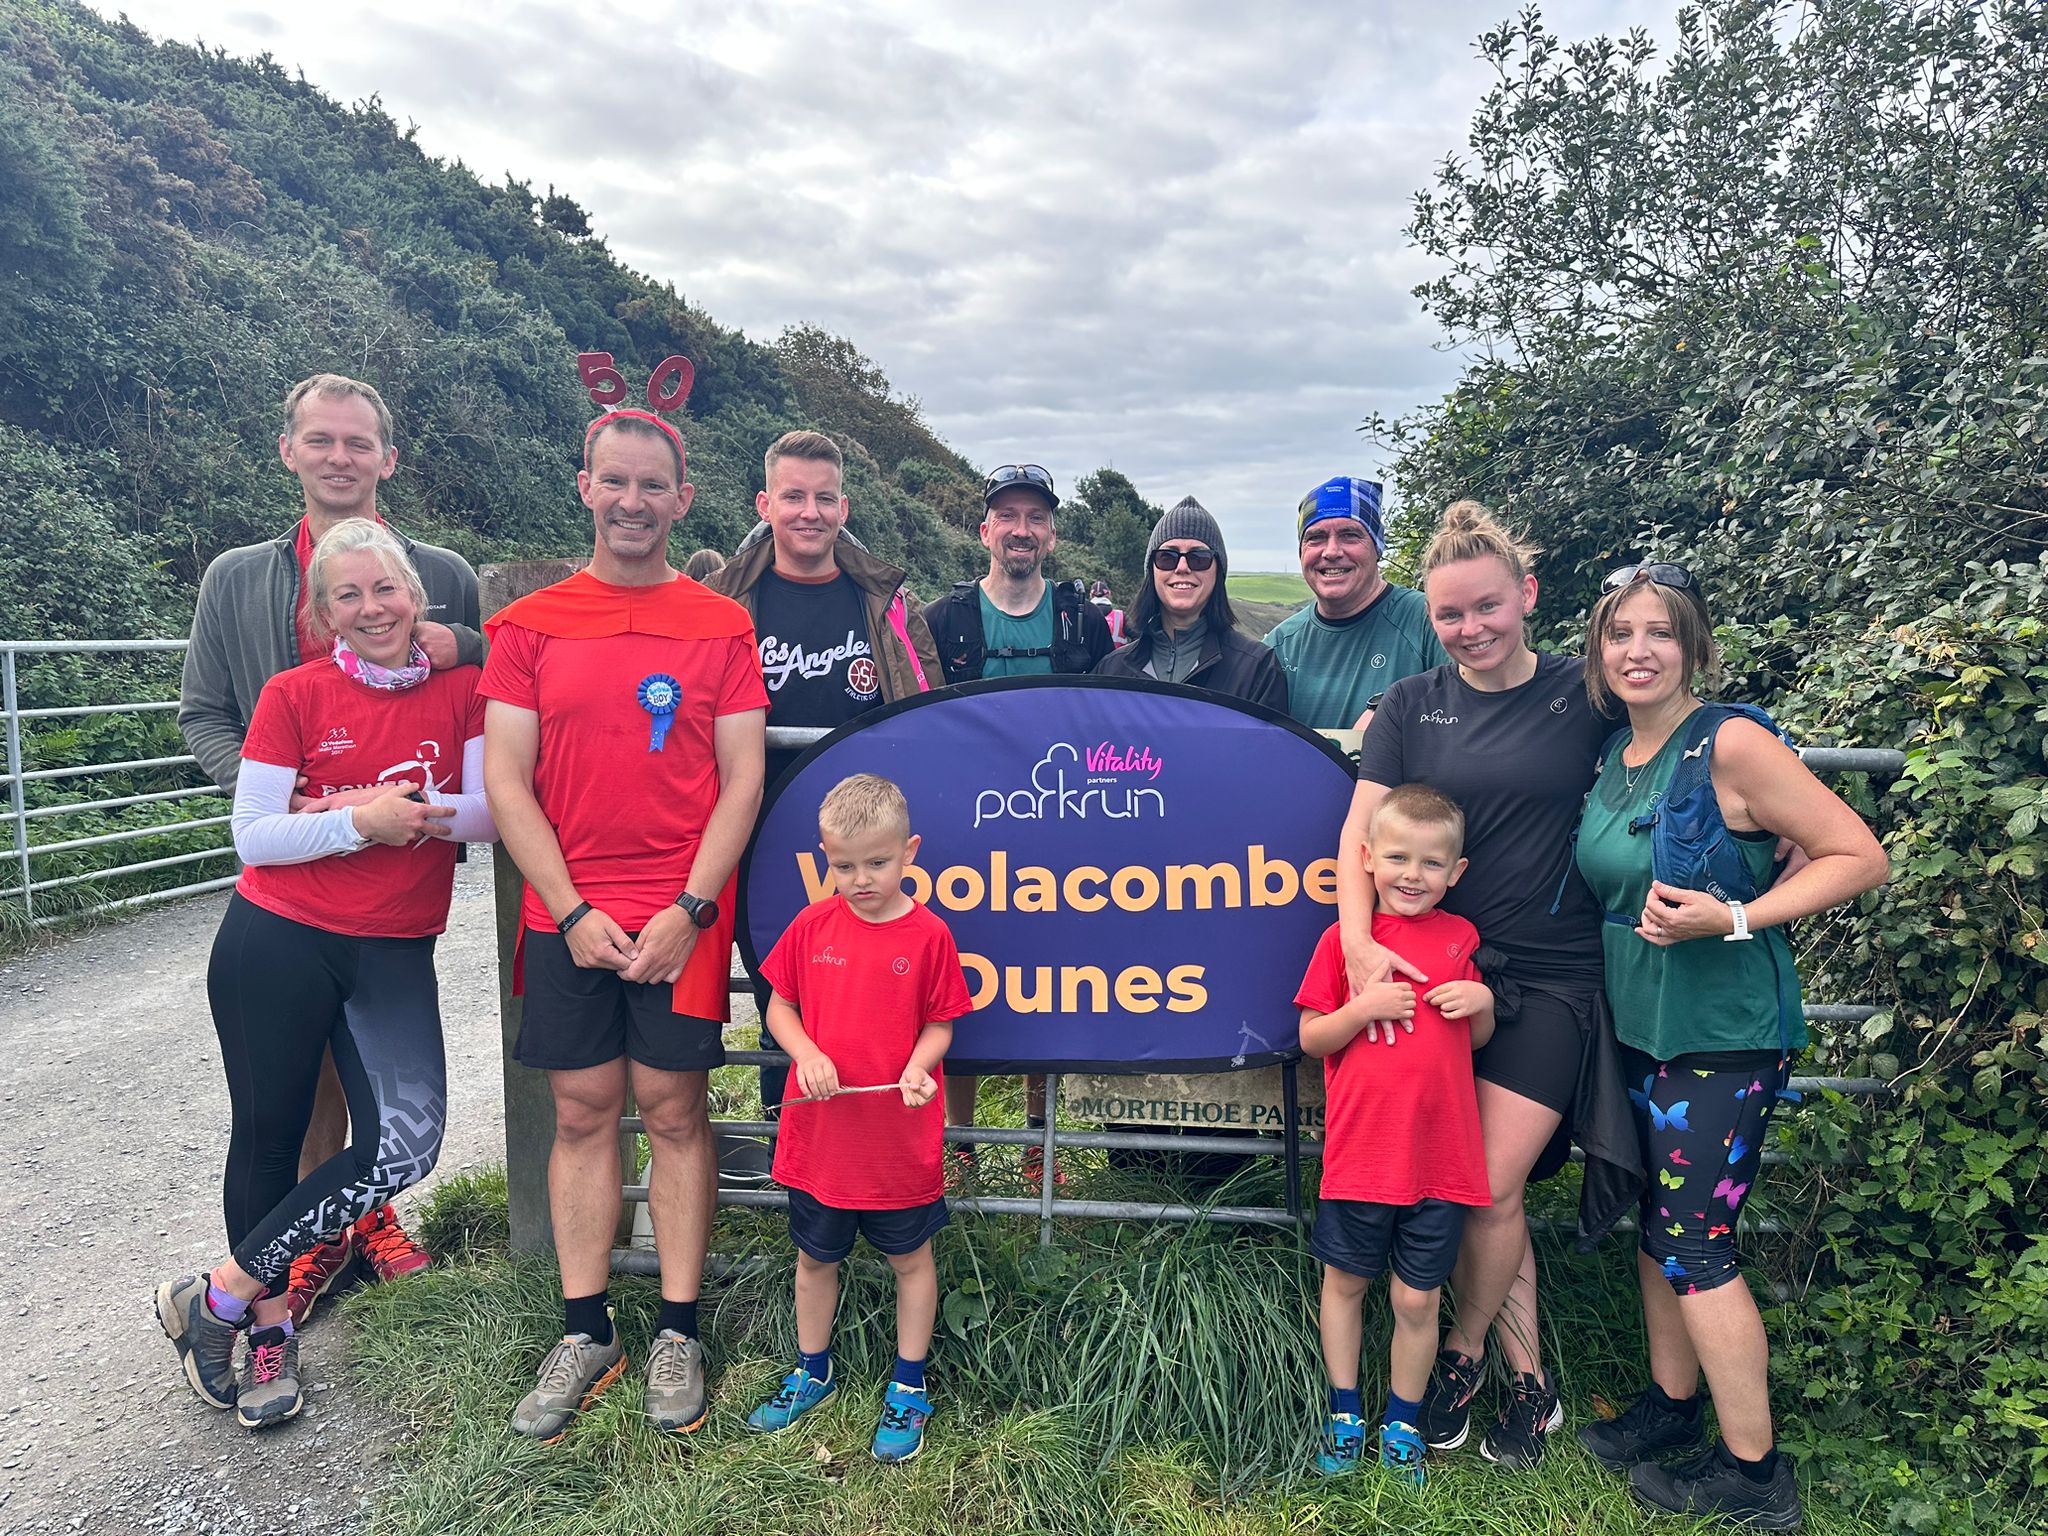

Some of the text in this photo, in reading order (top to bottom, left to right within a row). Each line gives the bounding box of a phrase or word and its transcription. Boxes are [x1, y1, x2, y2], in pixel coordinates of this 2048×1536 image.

[758, 636, 789, 674] Los
[653, 694, 668, 704] BOY
[1419, 709, 1459, 725] parkrun
[1086, 740, 1163, 781] Vitality
[973, 743, 1165, 829] parkrun
[1087, 776, 1117, 785] partners
[1706, 880, 1732, 901] CAMEL
[812, 946, 847, 967] parkrun
[1080, 1097, 1325, 1128] MORTEHOE PARIS
